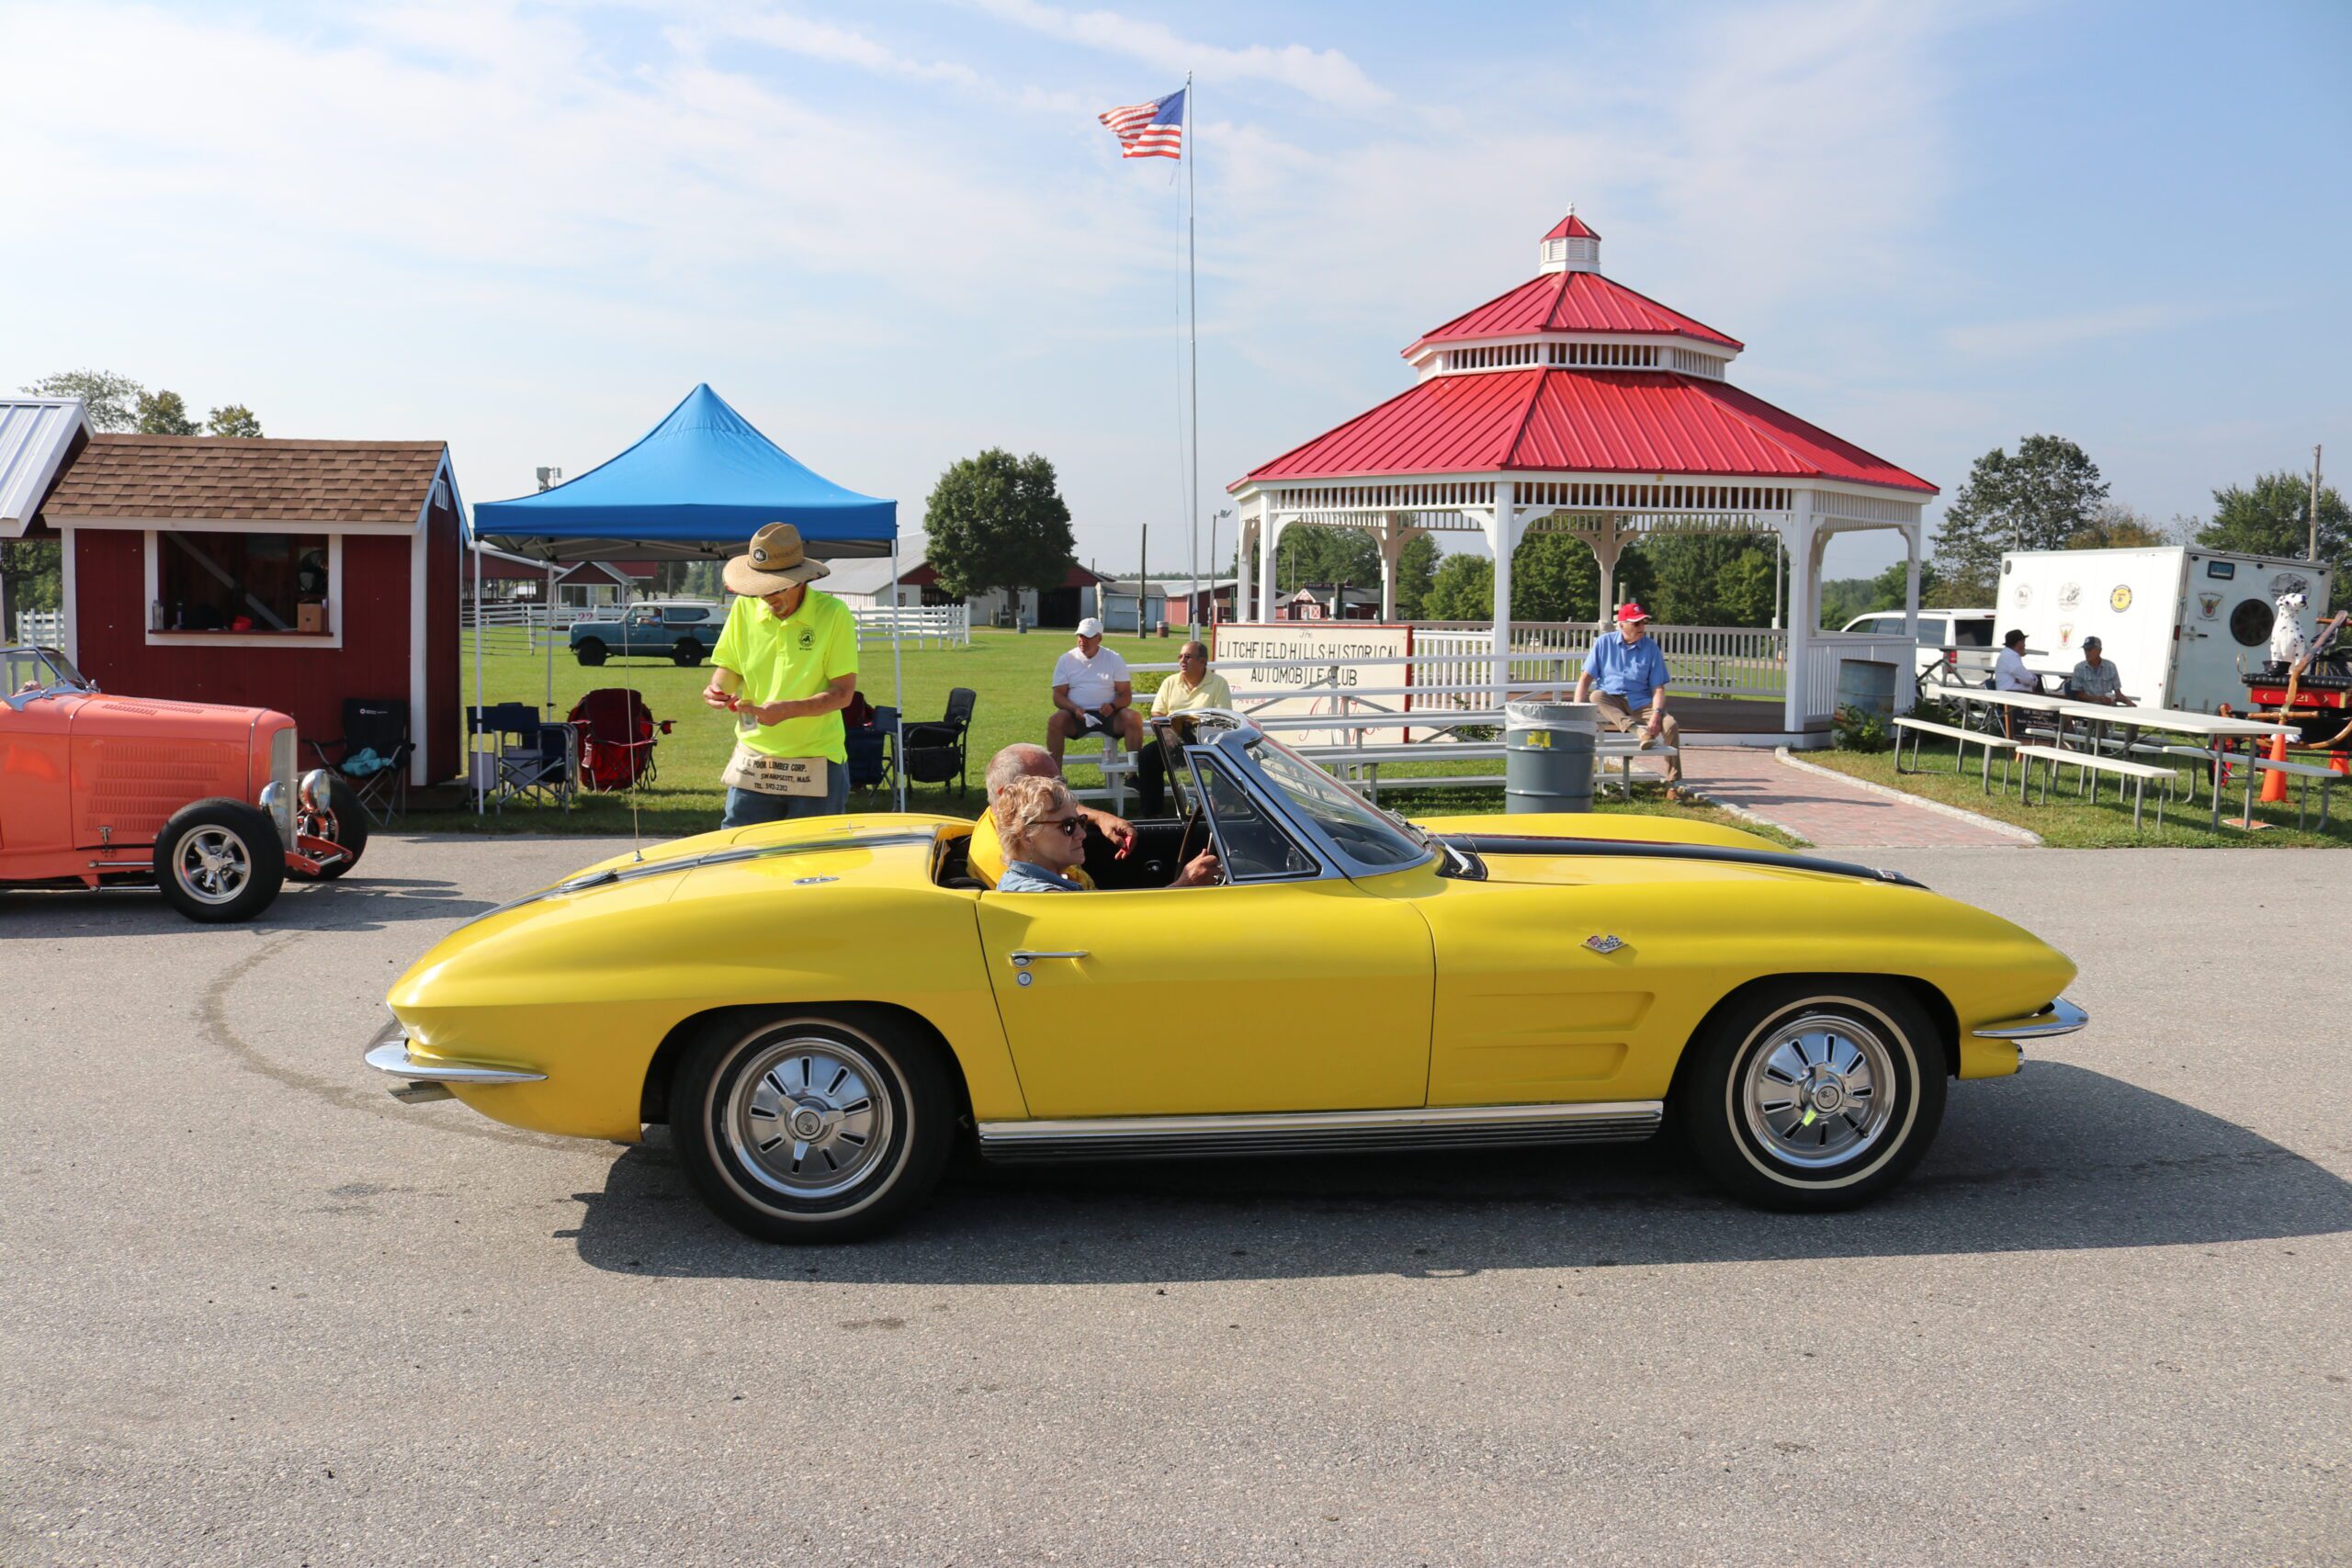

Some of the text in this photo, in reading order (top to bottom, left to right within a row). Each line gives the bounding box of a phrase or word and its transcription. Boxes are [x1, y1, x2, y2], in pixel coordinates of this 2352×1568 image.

[1218, 641, 1287, 660] LITCHFIELD
[1289, 643, 1326, 660] HILLS
[1250, 667, 1324, 684] AUTOMOBILE
[769, 761, 789, 771] LUMBER
[791, 763, 808, 773] CORP.
